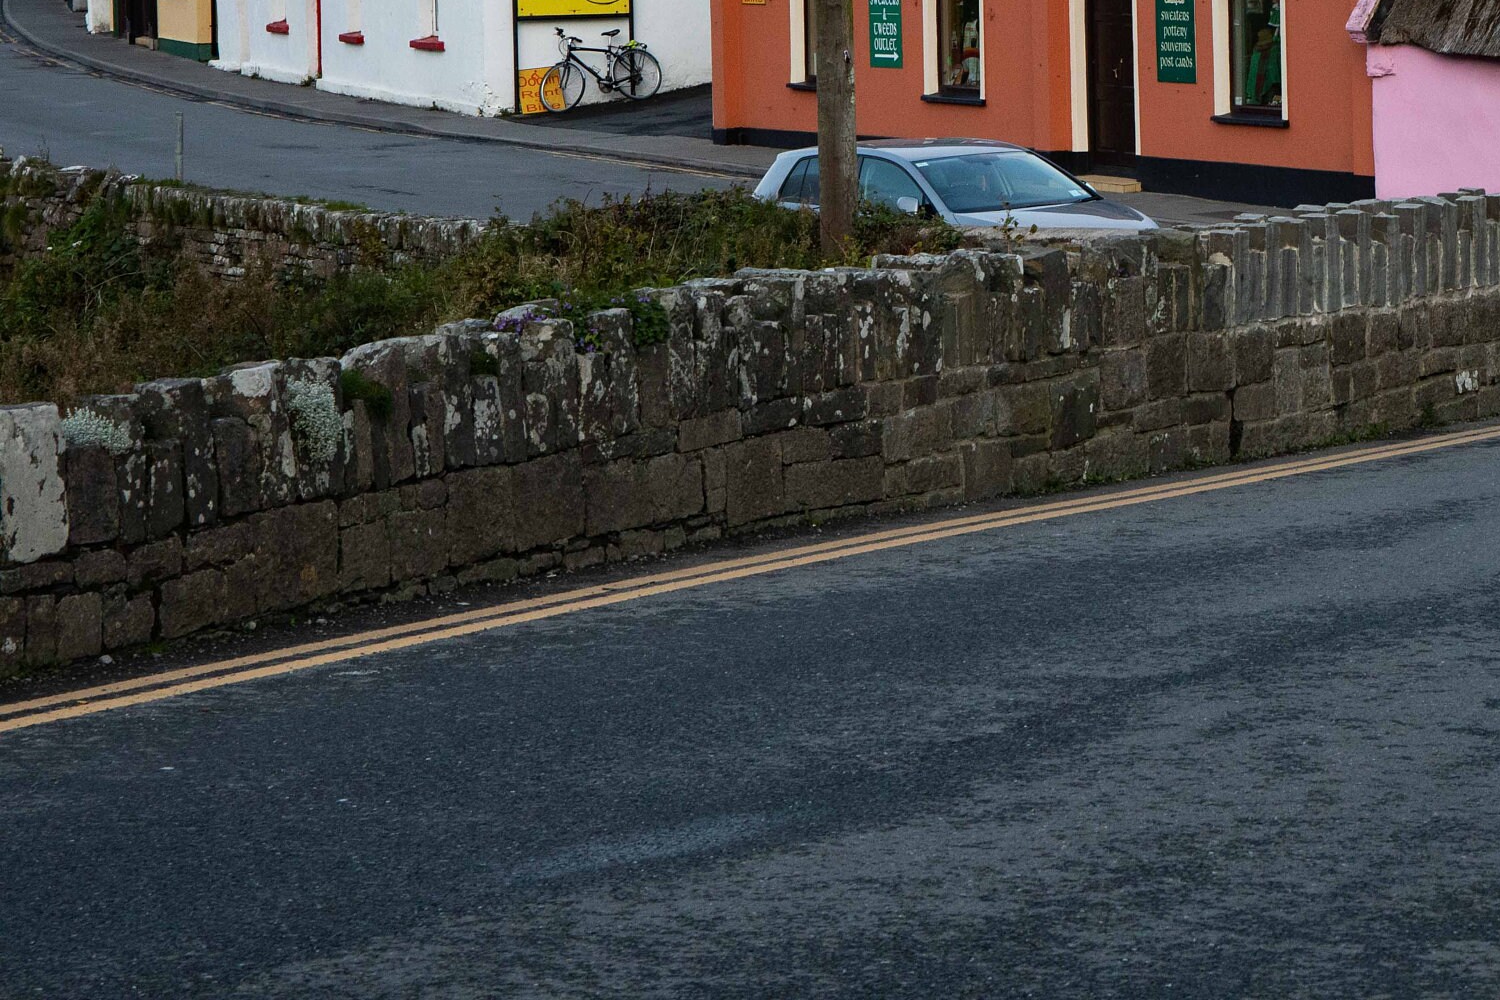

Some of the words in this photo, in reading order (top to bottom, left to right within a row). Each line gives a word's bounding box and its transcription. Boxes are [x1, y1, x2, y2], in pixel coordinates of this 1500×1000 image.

[873, 22, 897, 36] TWEEDS
[873, 38, 897, 51] OUTLET
[526, 103, 561, 112] Bie
